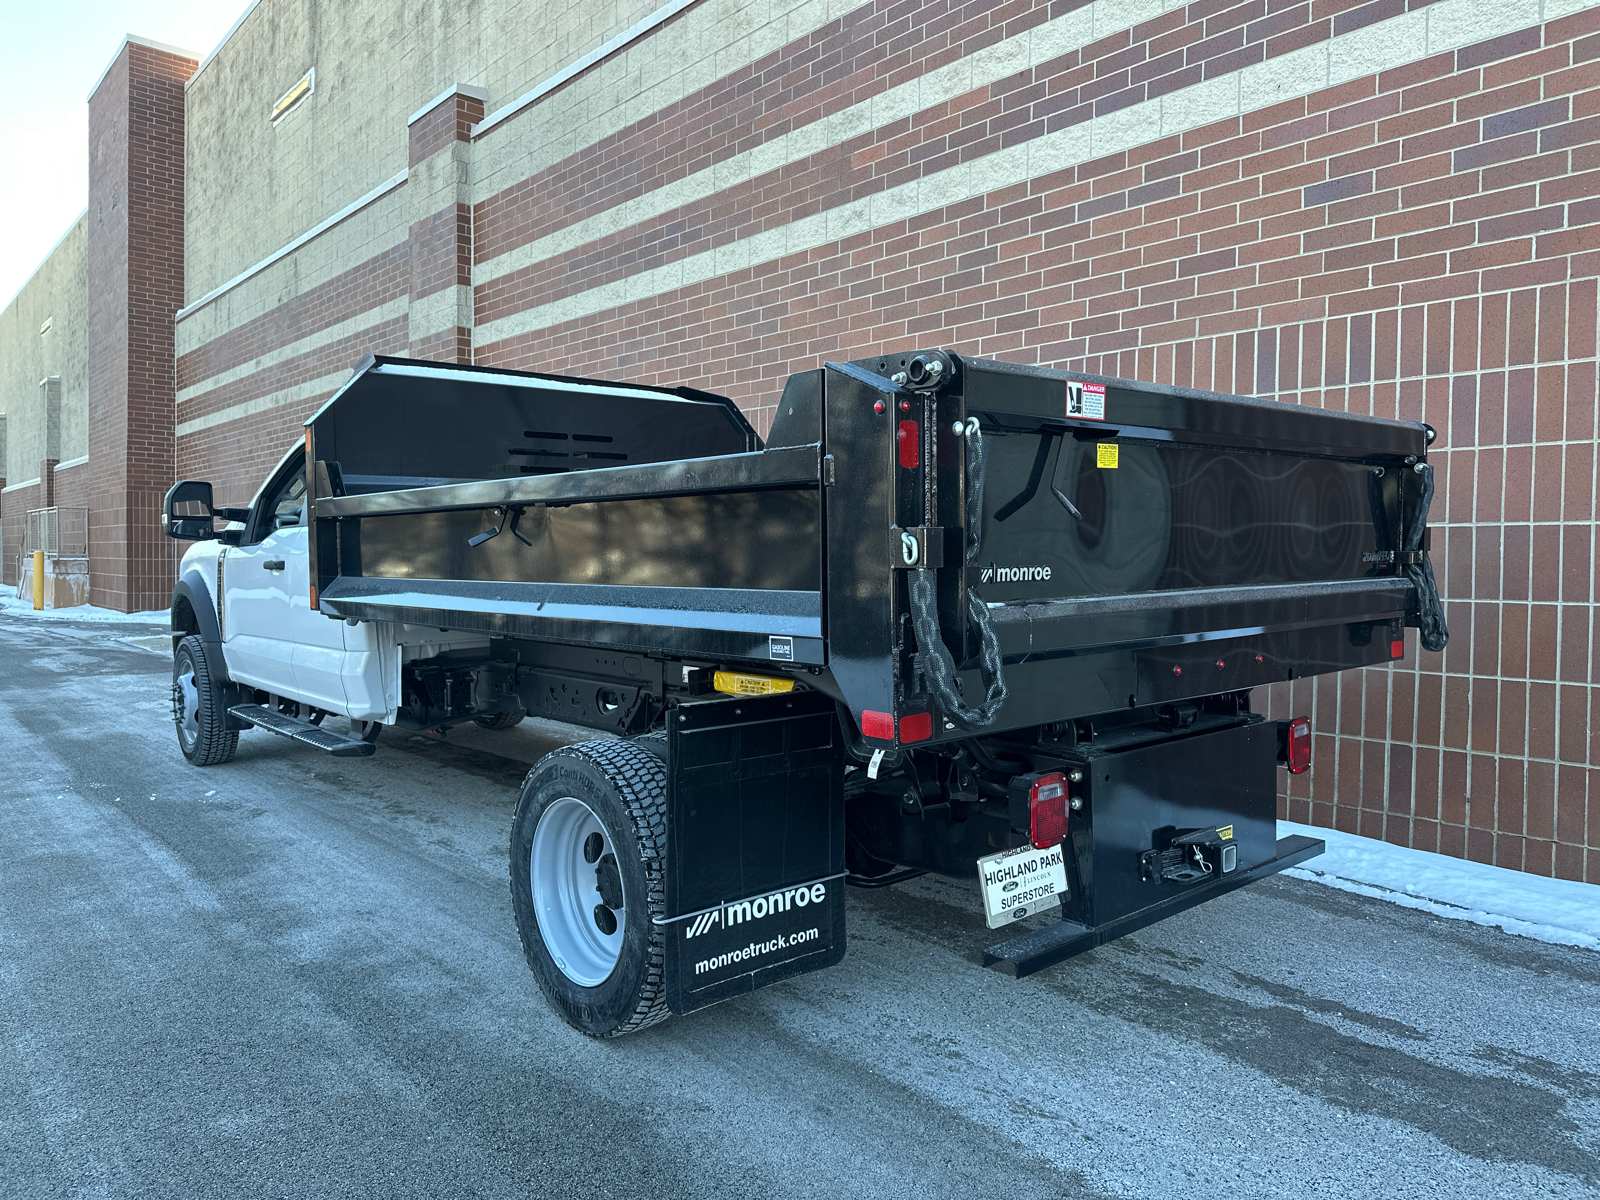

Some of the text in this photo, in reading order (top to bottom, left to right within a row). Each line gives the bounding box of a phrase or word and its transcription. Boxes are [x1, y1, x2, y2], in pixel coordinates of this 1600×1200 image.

[1087, 384, 1105, 392] DANGER
[996, 566, 1052, 582] monroe
[744, 678, 761, 686] CAUTION
[559, 766, 578, 781] Conti
[984, 851, 1063, 886] HIGHLAND PARK
[1003, 871, 1051, 892] Ford LINCOLN
[727, 883, 826, 926] monroe
[1001, 882, 1055, 910] SUPERSTORE
[695, 927, 819, 975] monroetruck.com
